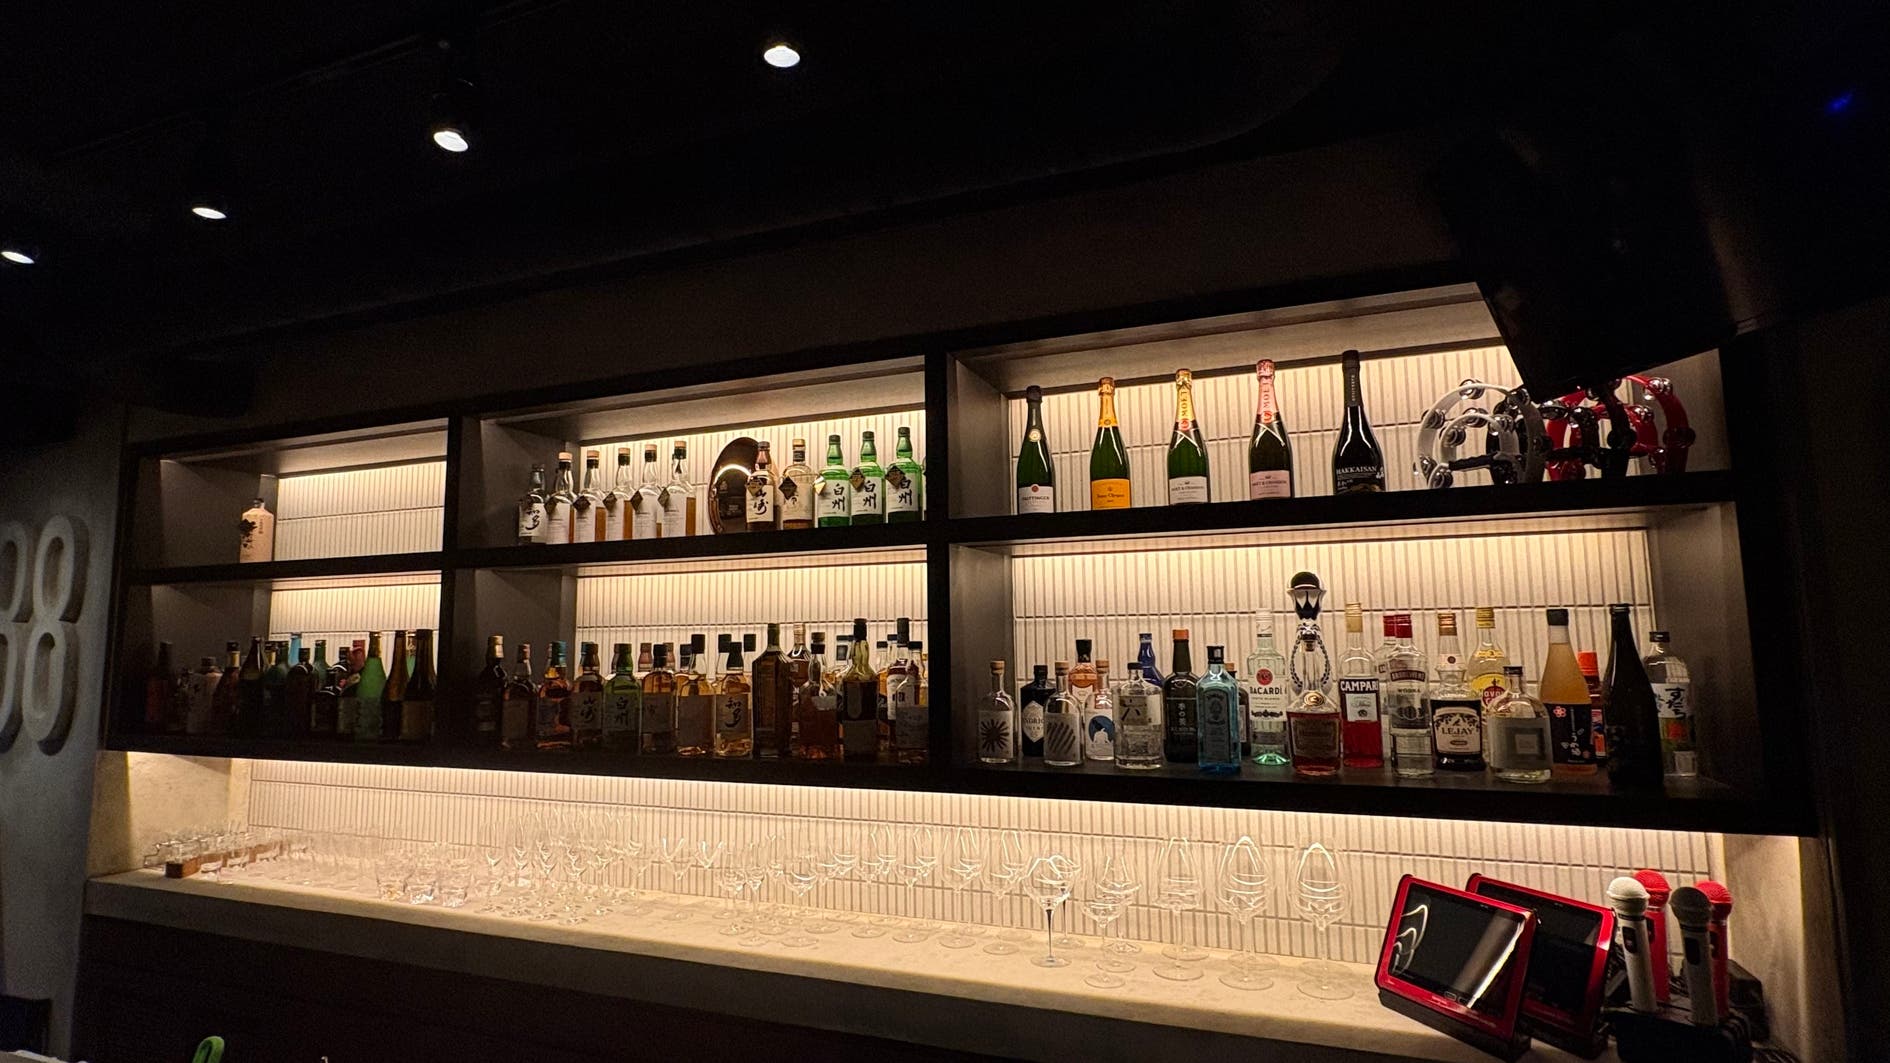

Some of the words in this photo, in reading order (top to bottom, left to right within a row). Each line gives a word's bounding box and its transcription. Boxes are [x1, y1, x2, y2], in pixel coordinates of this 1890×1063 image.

[1336, 465, 1378, 475] HAKKAISAN
[832, 483, 846, 513] 白州
[863, 480, 877, 510] 白州
[899, 477, 913, 506] 白州
[1340, 680, 1379, 692] CAMPARI
[1121, 698, 1147, 721] 六
[1665, 687, 1686, 720] すだち
[1441, 726, 1474, 735] LEJAY
